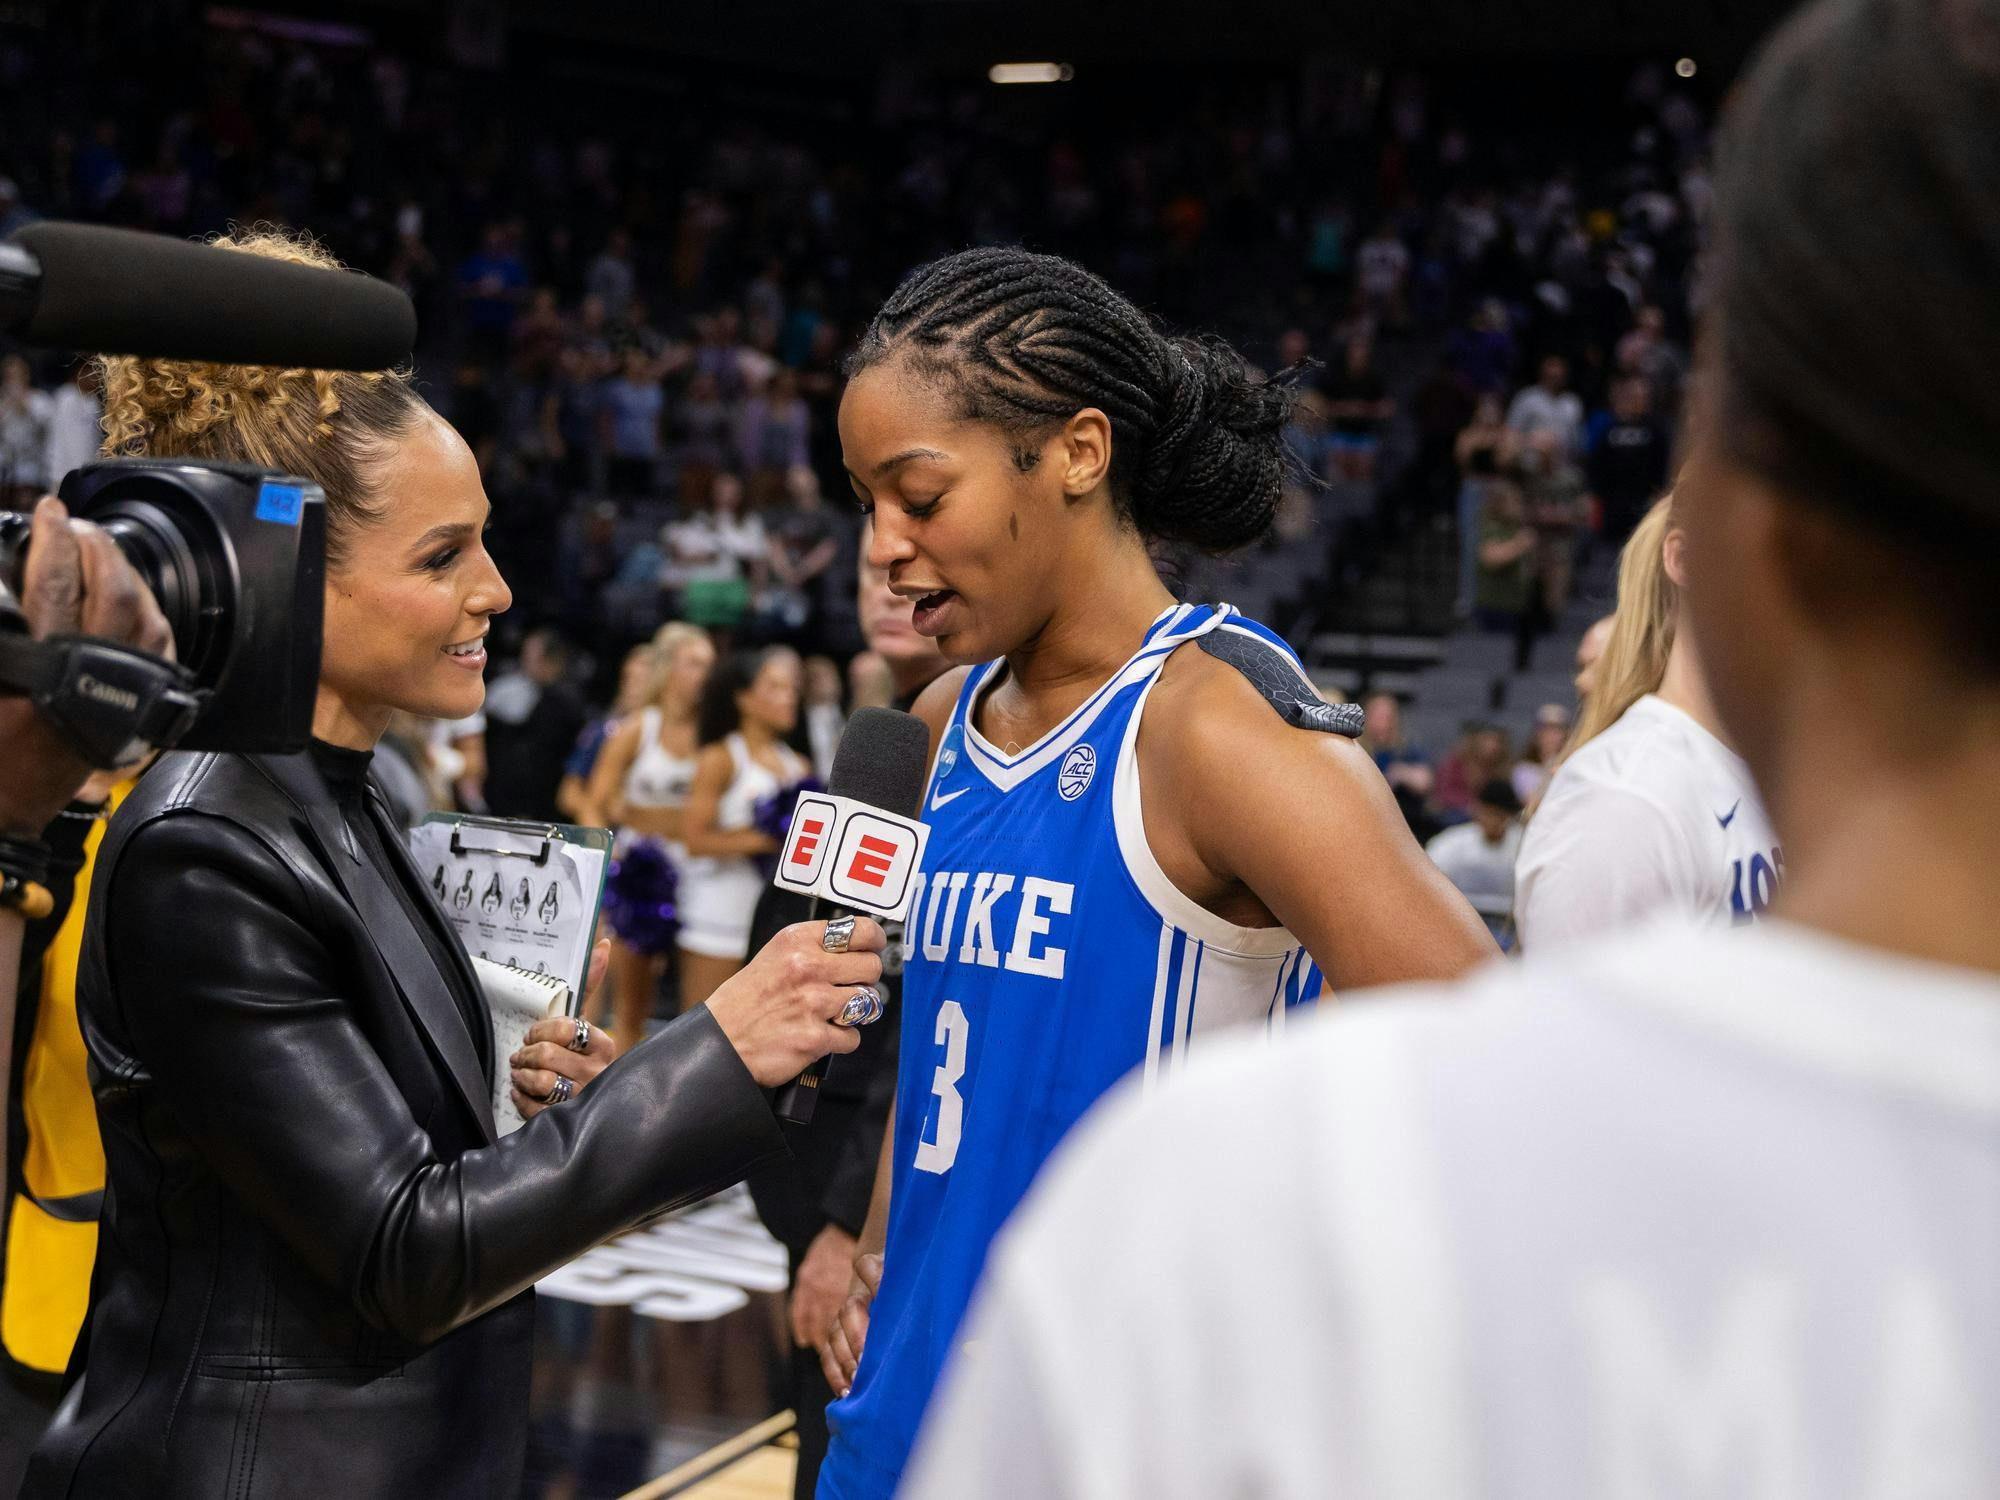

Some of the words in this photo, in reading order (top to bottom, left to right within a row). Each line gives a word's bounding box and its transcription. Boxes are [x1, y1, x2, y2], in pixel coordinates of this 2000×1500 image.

[79, 674, 138, 711] Canon
[1064, 762, 1094, 776] ACC
[790, 819, 825, 867] E
[846, 834, 899, 888] E
[913, 999, 970, 1176] 3
